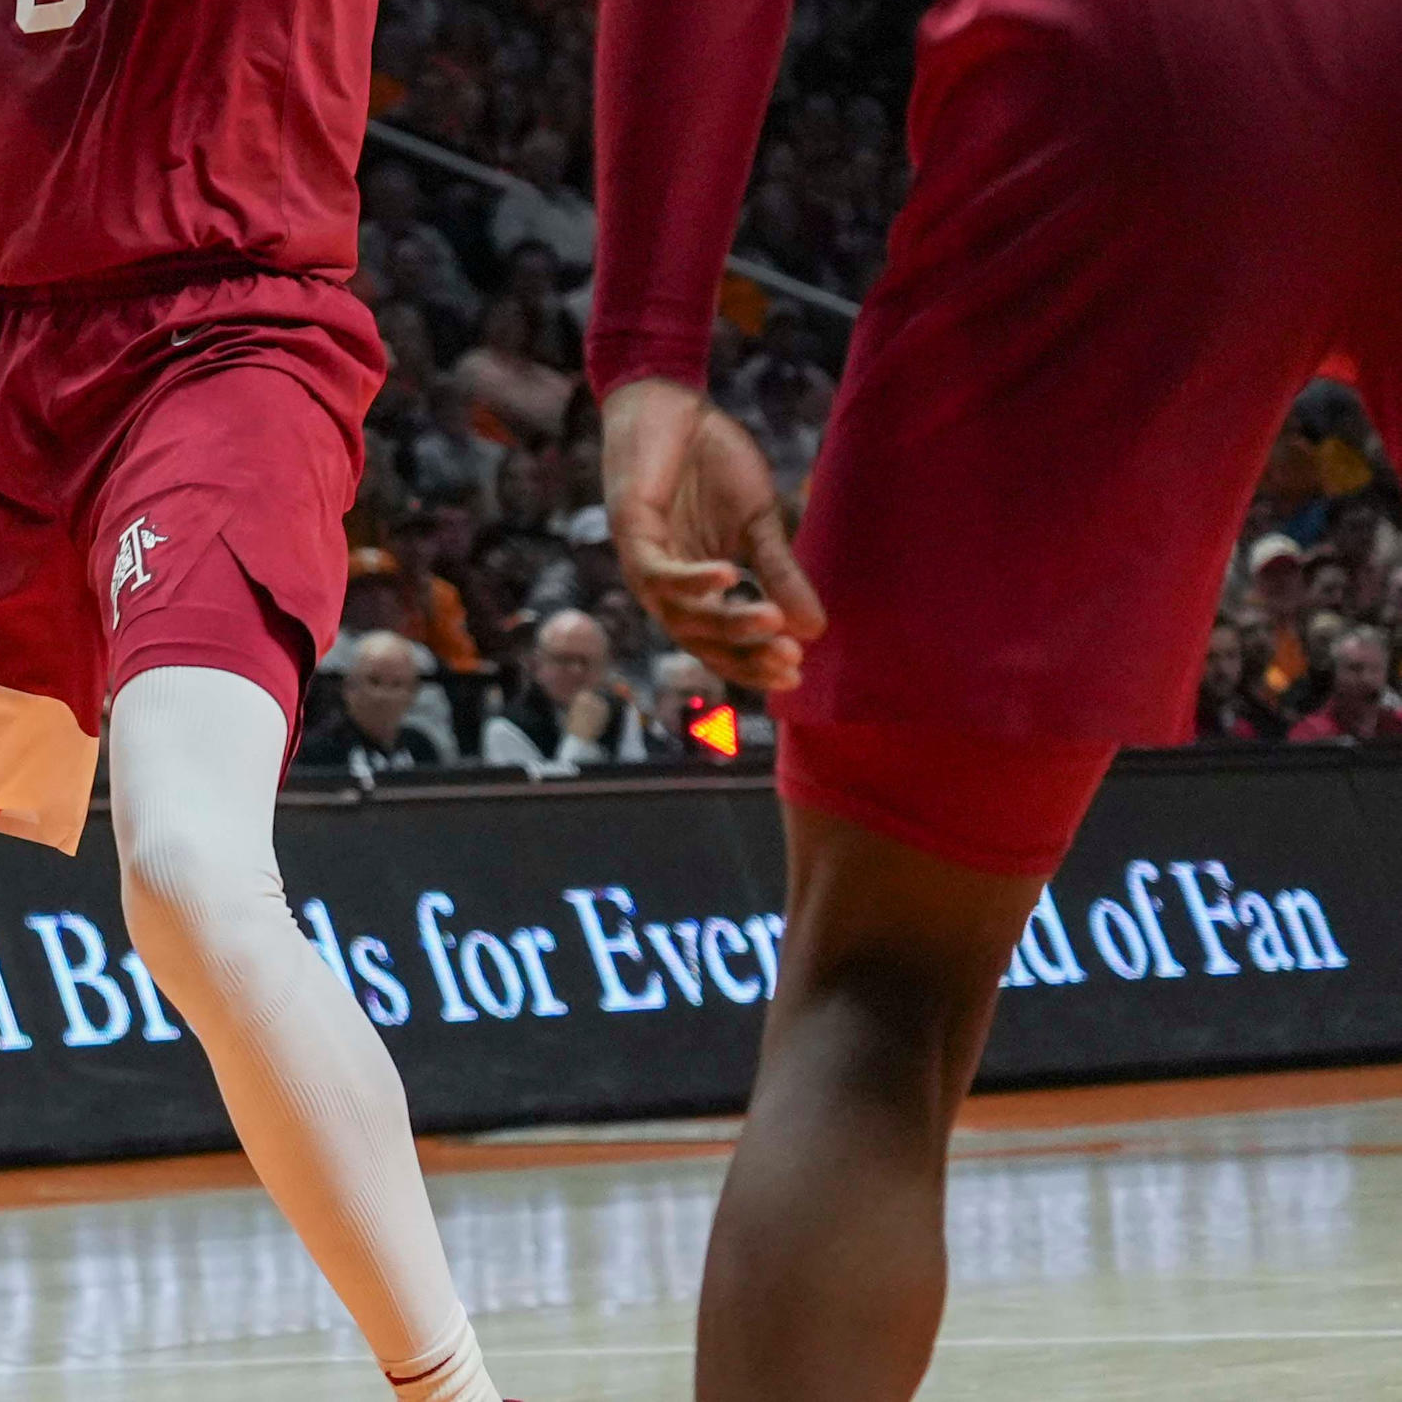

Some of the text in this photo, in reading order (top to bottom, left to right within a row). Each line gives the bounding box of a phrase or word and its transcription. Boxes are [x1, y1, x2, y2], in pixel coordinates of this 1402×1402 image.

[416, 889, 570, 1023] for
[561, 882, 788, 1014] Ever
[1088, 858, 1188, 981] of
[1168, 858, 1350, 976] Fan
